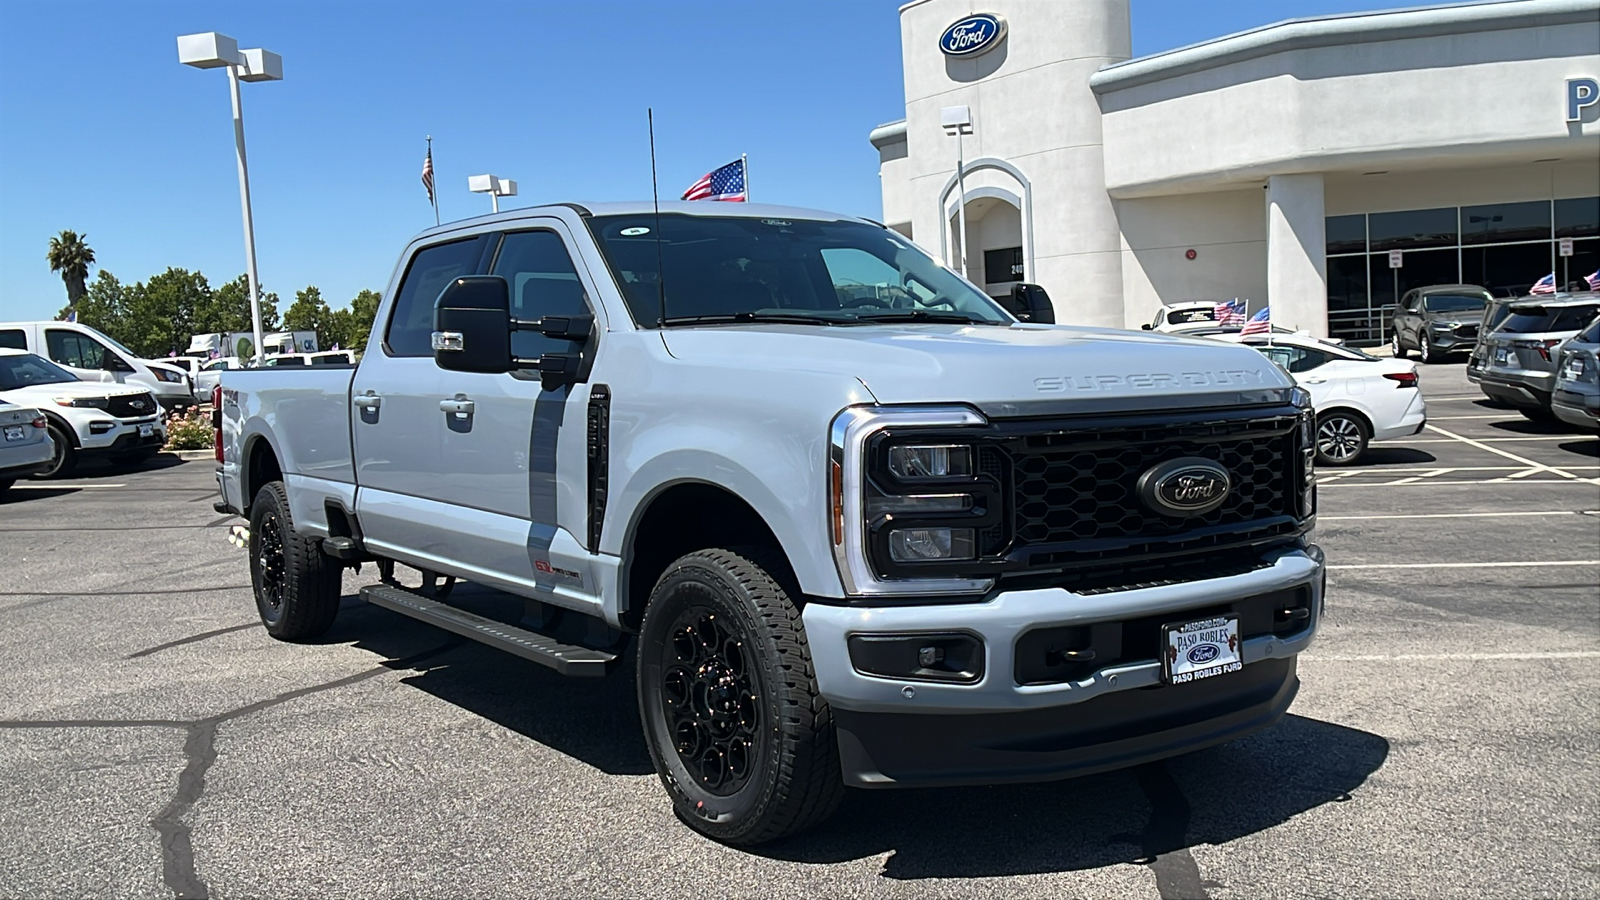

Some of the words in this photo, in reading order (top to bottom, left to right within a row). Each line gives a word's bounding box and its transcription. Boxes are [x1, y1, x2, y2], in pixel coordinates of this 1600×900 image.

[950, 22, 986, 50] Ford
[1033, 374, 1179, 392] SUPER
[1181, 369, 1264, 388] DUTY
[1174, 474, 1215, 500] Ford
[1177, 634, 1197, 652] PASO
[1200, 629, 1229, 644] ROBLES
[1194, 647, 1214, 660] Ford
[1173, 673, 1192, 684] PASO
[1194, 667, 1222, 679] ROBLES
[1223, 663, 1242, 674] FORD
